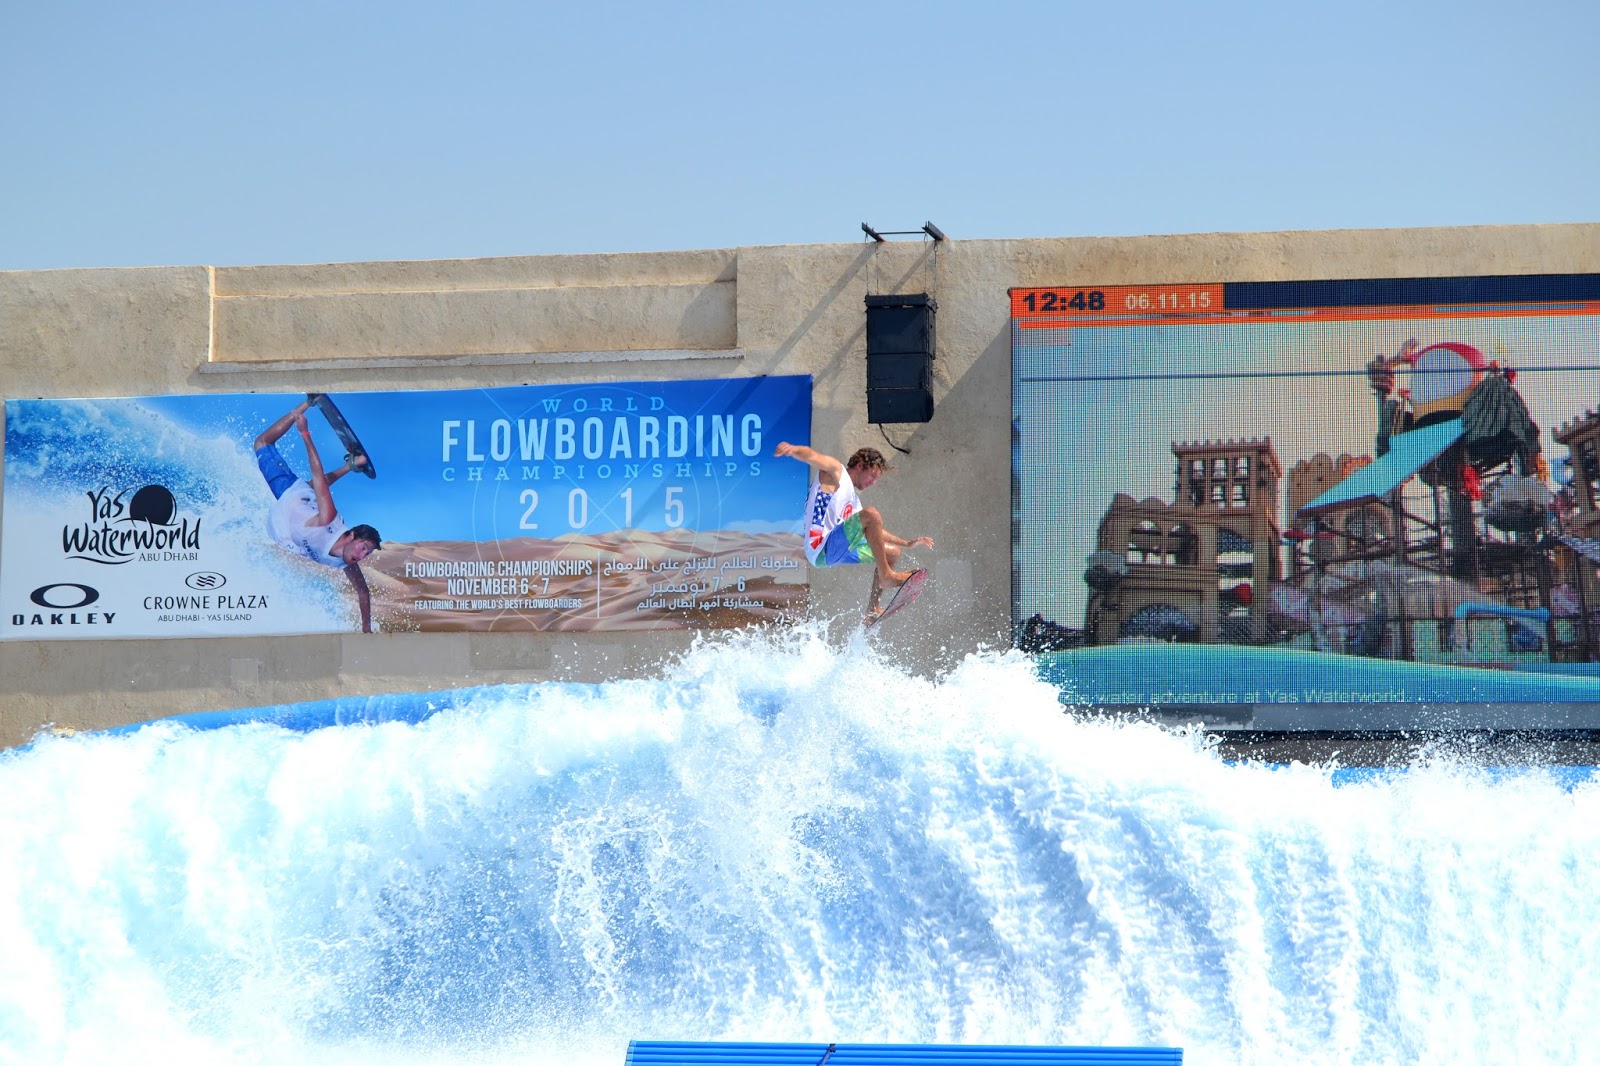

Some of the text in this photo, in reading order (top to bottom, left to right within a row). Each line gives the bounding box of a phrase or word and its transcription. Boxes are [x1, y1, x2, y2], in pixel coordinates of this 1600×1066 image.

[1023, 291, 1211, 312] 12:48 06.11.15
[542, 396, 666, 413] WORLD
[442, 413, 763, 463] FLOWBOARDING
[442, 461, 762, 482] CHAMPIONSHIPS
[87, 486, 131, 524] Yas
[518, 486, 685, 530] 2015
[62, 517, 201, 557] Waterworld
[138, 551, 198, 562] ABU DHABI
[405, 560, 593, 578] FLOWBOARDING CHAMPIONSHIPS
[603, 556, 800, 576] بطولة العالم للتزلج على الأمواج
[447, 578, 518, 596] NOVEMBER
[520, 578, 529, 595] 6
[541, 578, 550, 594] 7
[650, 579, 706, 597] نوفمبر
[712, 576, 720, 592] 7
[737, 575, 746, 592] 6
[143, 595, 268, 610] CROWNE PLAZA
[414, 598, 583, 610] FEATURING THE WORLD'S BEST FLOWBOARDERS
[636, 598, 666, 612] العالم
[722, 596, 764, 610] بمشاركة
[12, 612, 117, 626] OAKLEY
[157, 614, 175, 622] ABU
[175, 614, 201, 622] DHABI
[206, 613, 222, 621] YAS
[222, 613, 252, 621] ISLAND
[1265, 688, 1298, 704] Yas
[1303, 688, 1405, 704] Waterworld
